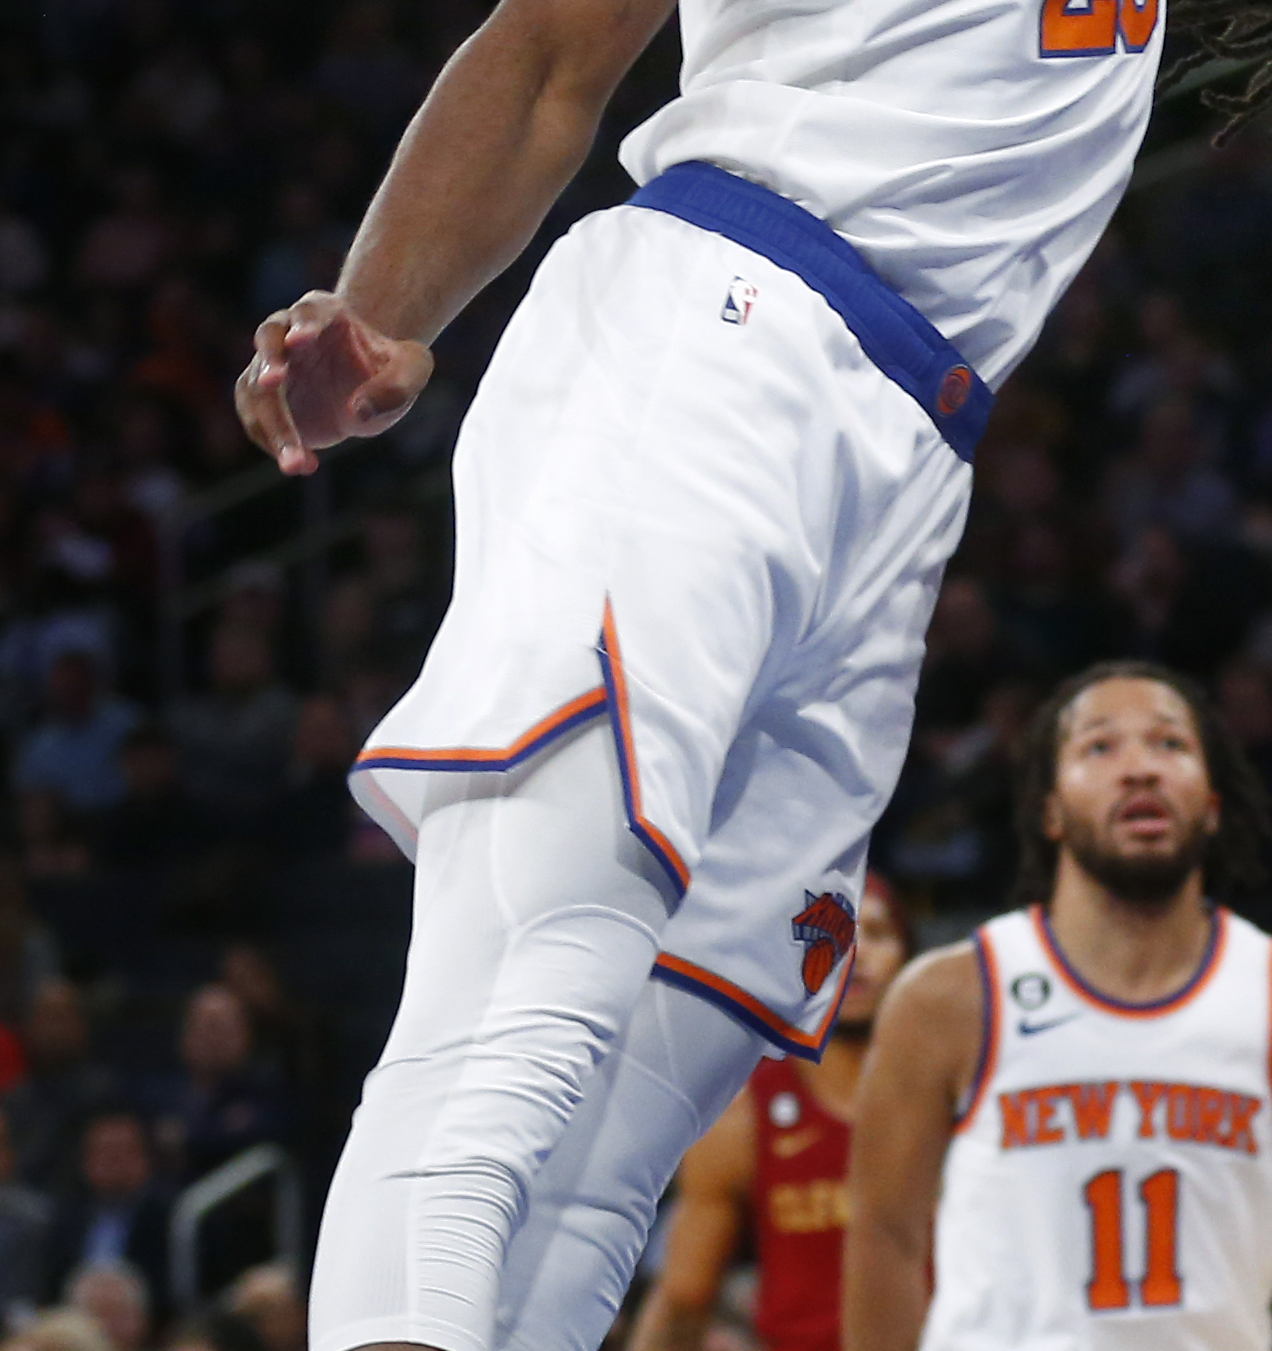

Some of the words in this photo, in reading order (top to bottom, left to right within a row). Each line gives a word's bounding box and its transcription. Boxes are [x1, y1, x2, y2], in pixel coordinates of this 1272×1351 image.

[998, 1081, 1118, 1149] NEW
[1128, 1080, 1261, 1155] YORK
[1084, 1167, 1182, 1311] 11
